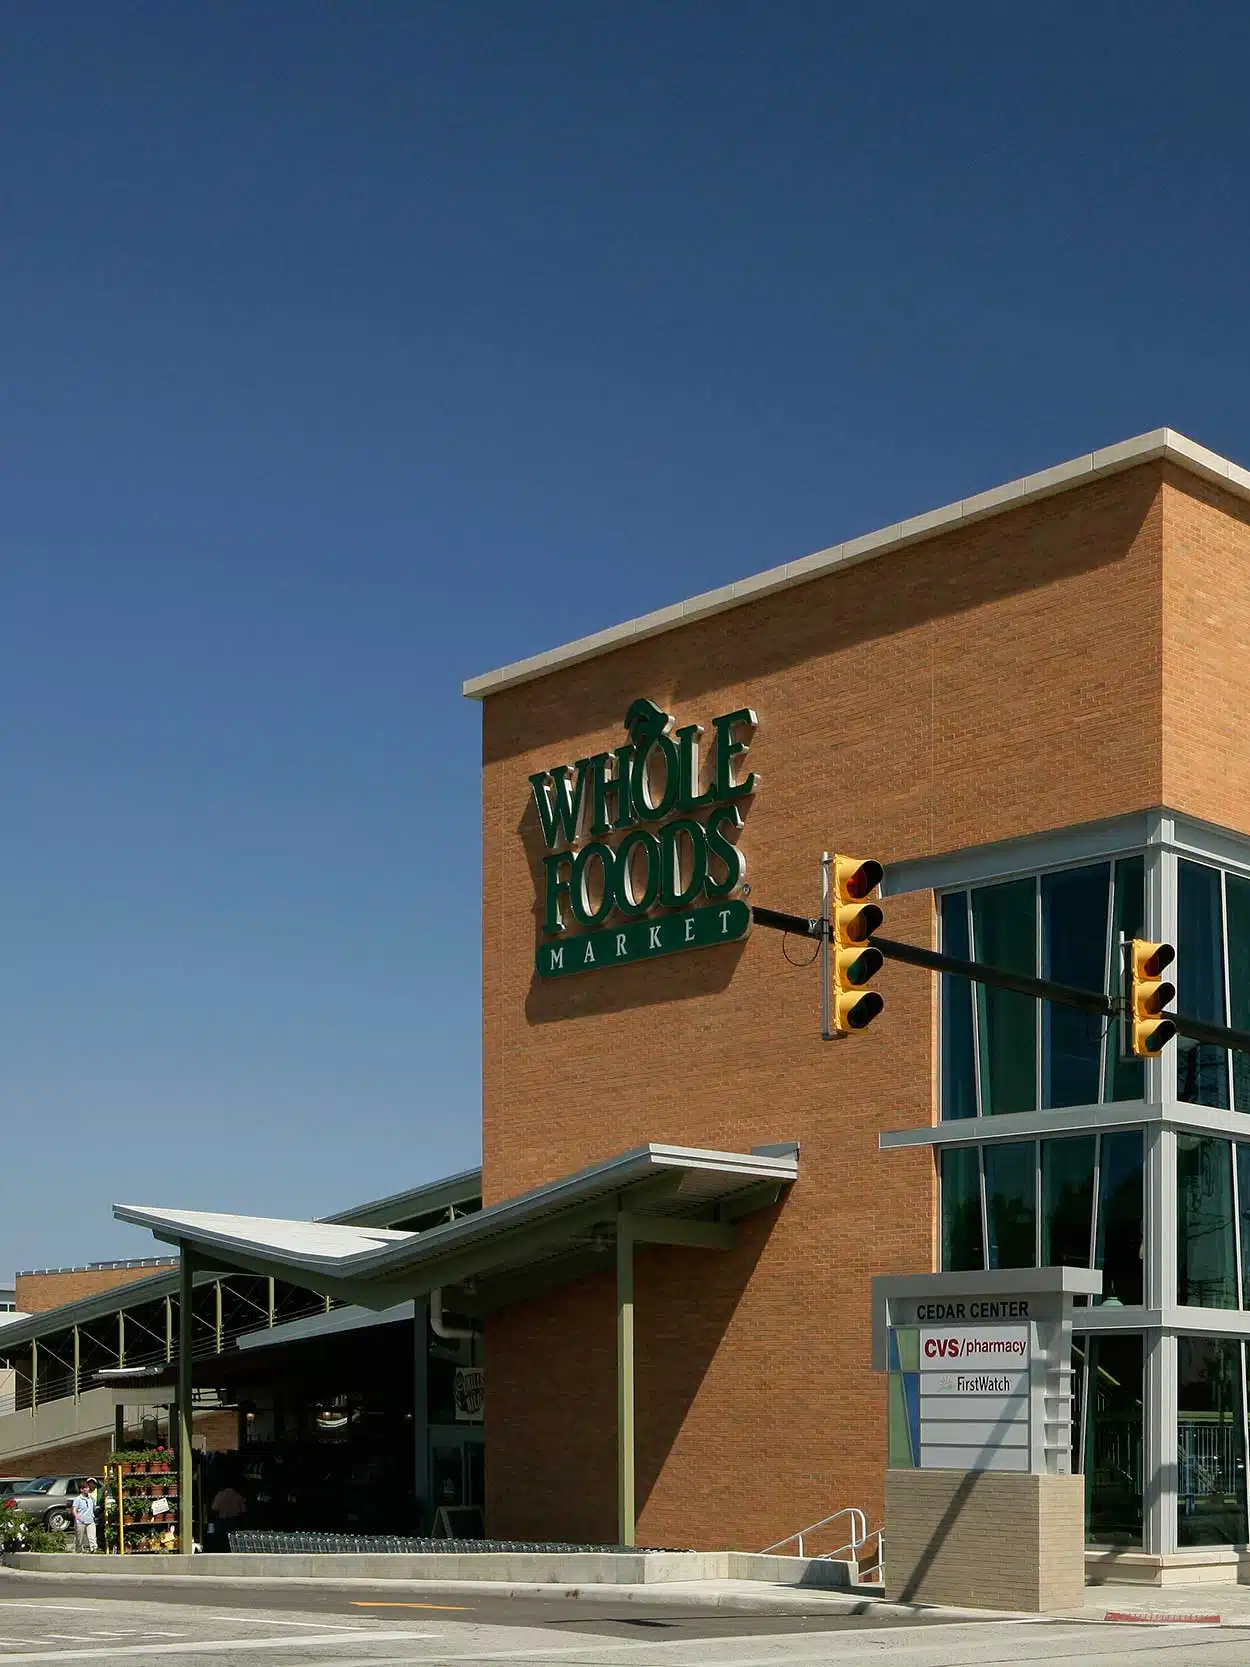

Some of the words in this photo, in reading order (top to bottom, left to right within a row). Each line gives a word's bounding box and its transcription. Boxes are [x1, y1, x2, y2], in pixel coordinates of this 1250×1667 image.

[528, 707, 760, 848] WHOLE
[542, 805, 749, 936] FOODS
[550, 910, 731, 971] MARKET
[917, 1304, 965, 1320] CEDAR
[970, 1301, 1029, 1318] CENTER
[924, 1338, 1026, 1358] CVS/pharmacy
[957, 1376, 1010, 1392] FirstWatch
